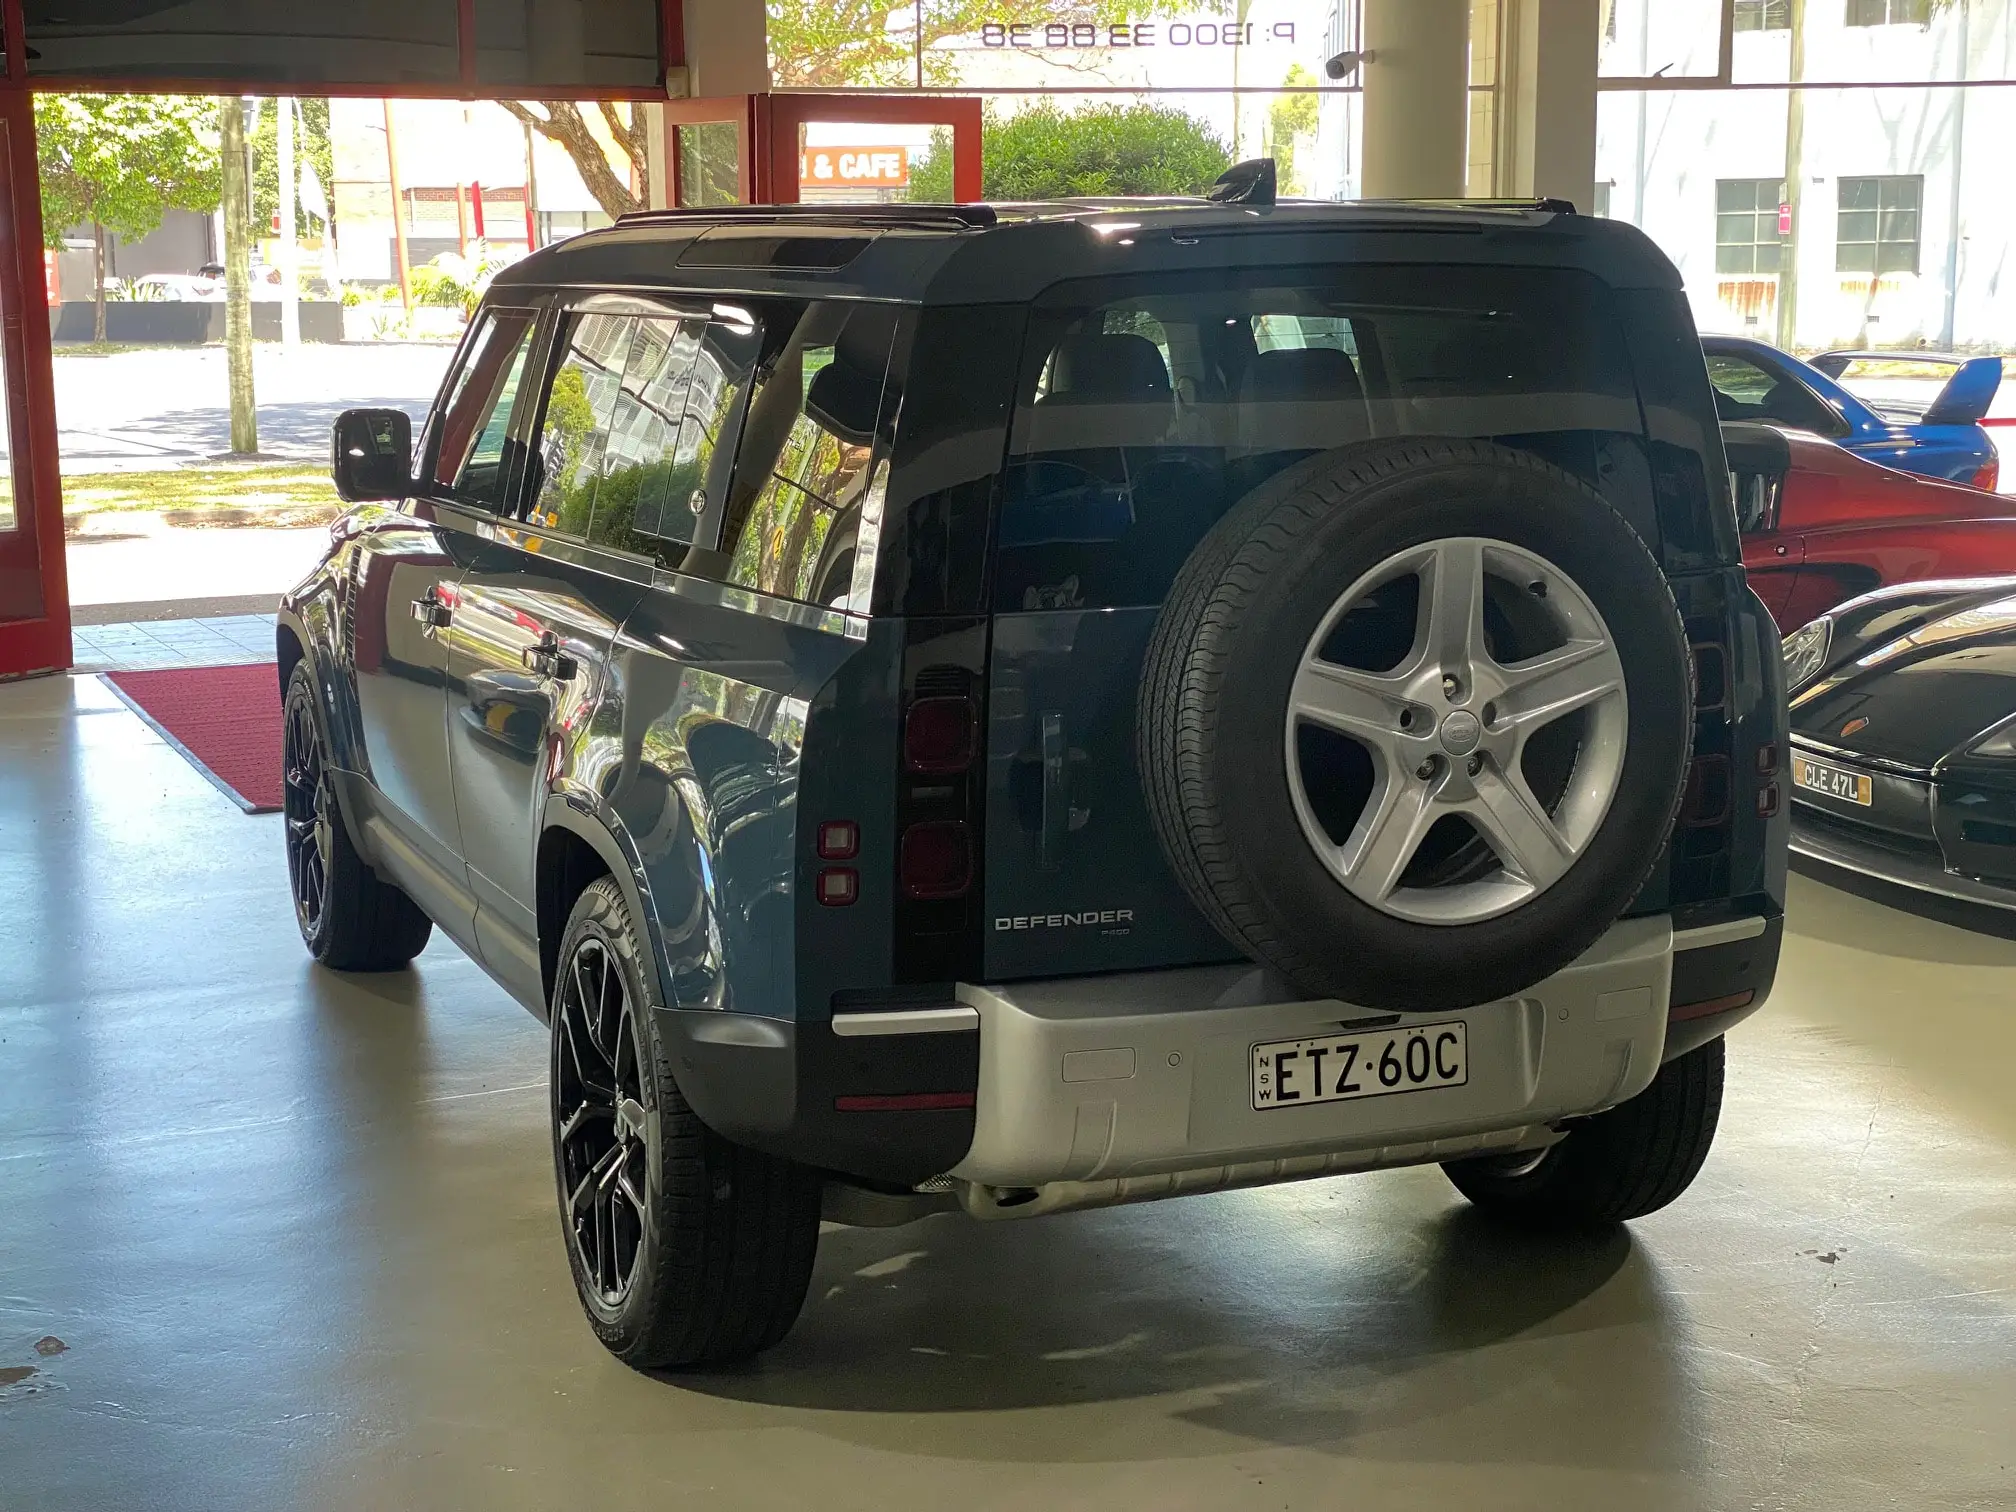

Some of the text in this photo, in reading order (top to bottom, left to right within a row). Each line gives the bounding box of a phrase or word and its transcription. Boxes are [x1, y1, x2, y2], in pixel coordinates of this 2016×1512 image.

[813, 153, 833, 179] &
[839, 153, 901, 179] CAFE
[1805, 764, 1858, 799] CLE 47L
[995, 909, 1134, 931] DEFENDER
[1101, 928, 1130, 936] P400
[1259, 1056, 1271, 1101] NSW
